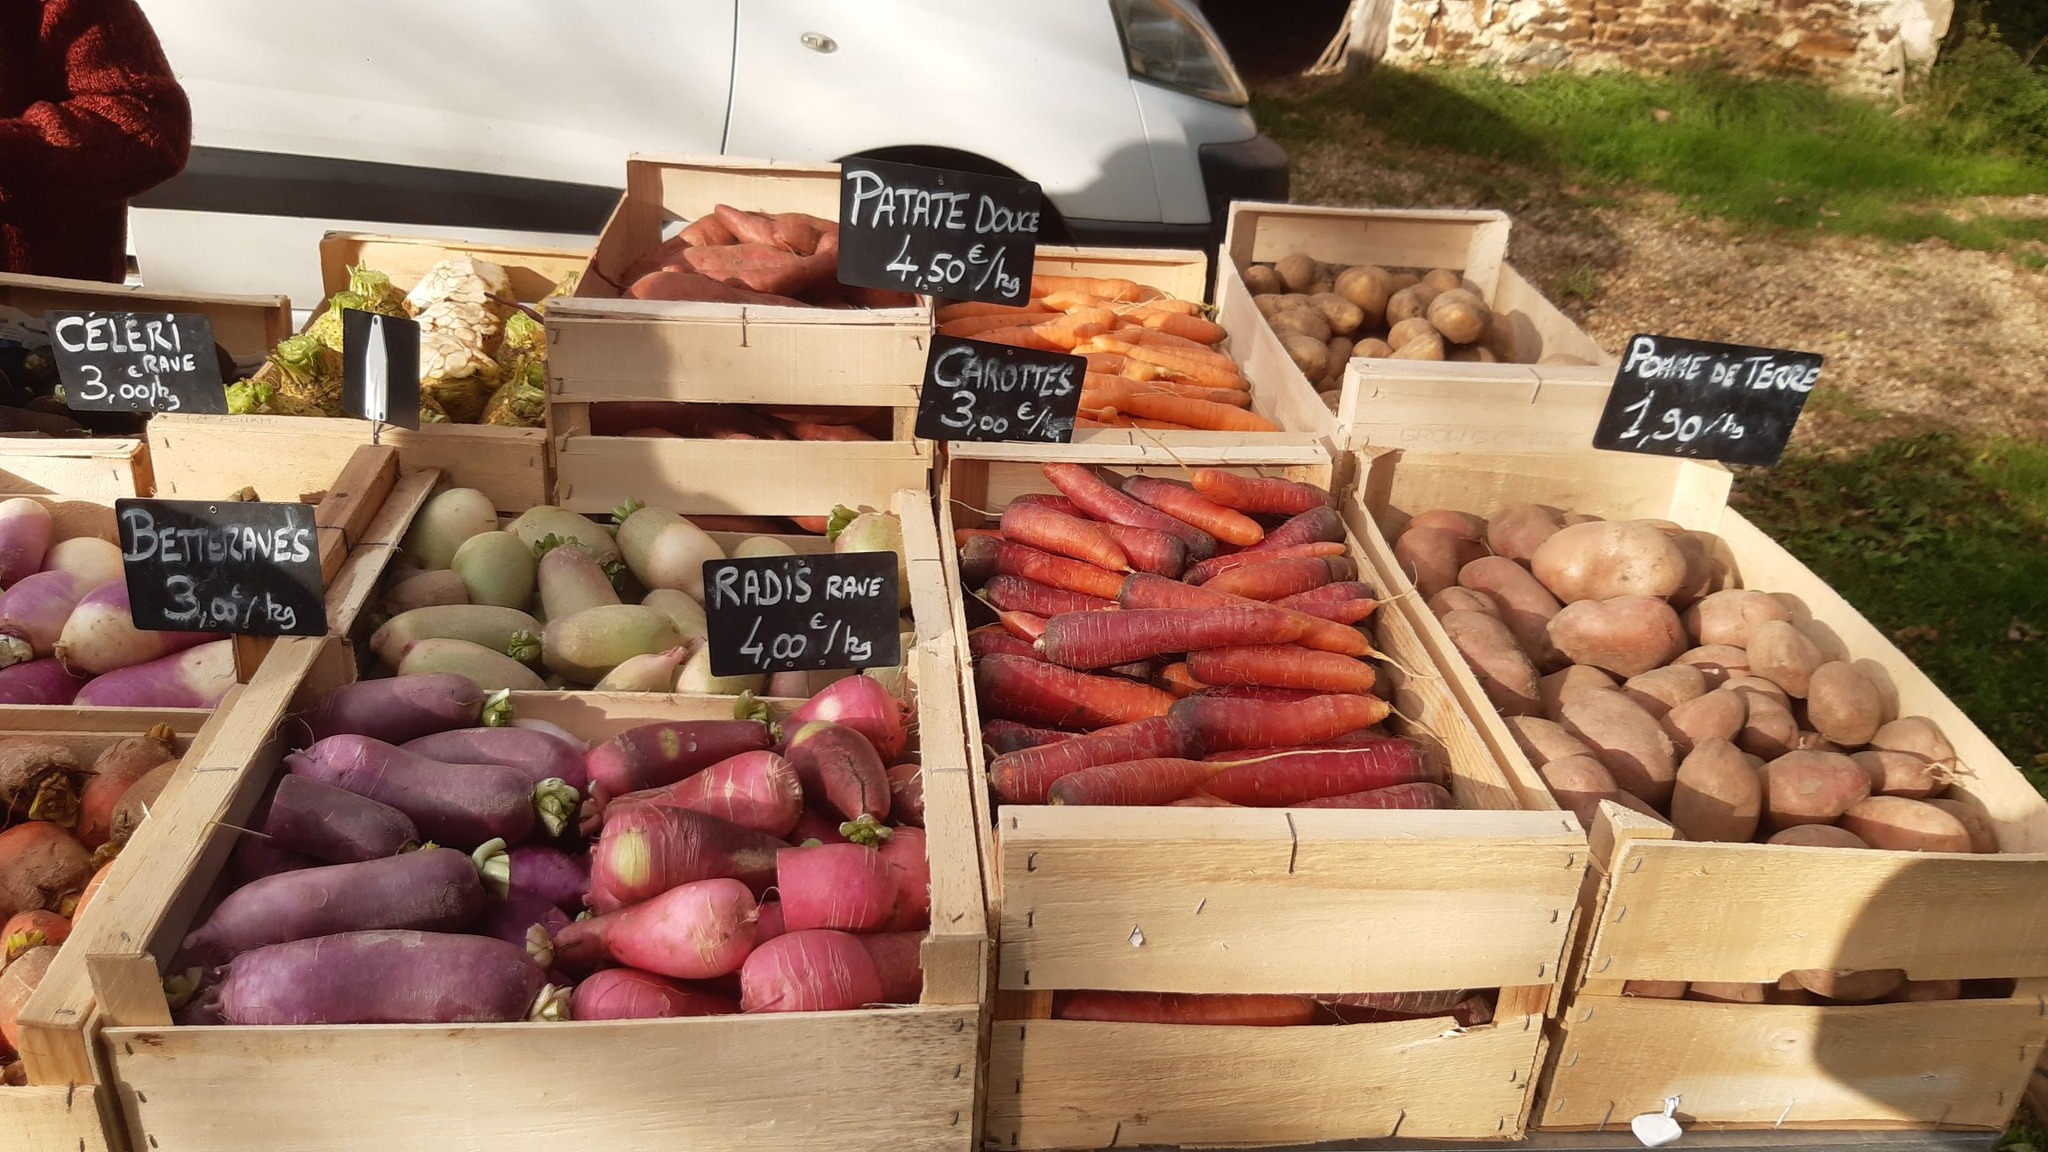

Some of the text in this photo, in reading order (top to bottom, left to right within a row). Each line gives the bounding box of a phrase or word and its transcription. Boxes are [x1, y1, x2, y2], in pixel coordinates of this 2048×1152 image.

[847, 170, 1040, 234] PATATE DOUCE
[143, 354, 196, 374] RAVE
[934, 346, 1075, 397] CAROTTES
[1624, 337, 1821, 393] POMME DE TERRE
[122, 507, 312, 563] BETTERAVES
[715, 562, 884, 610] RADiS RAVE
